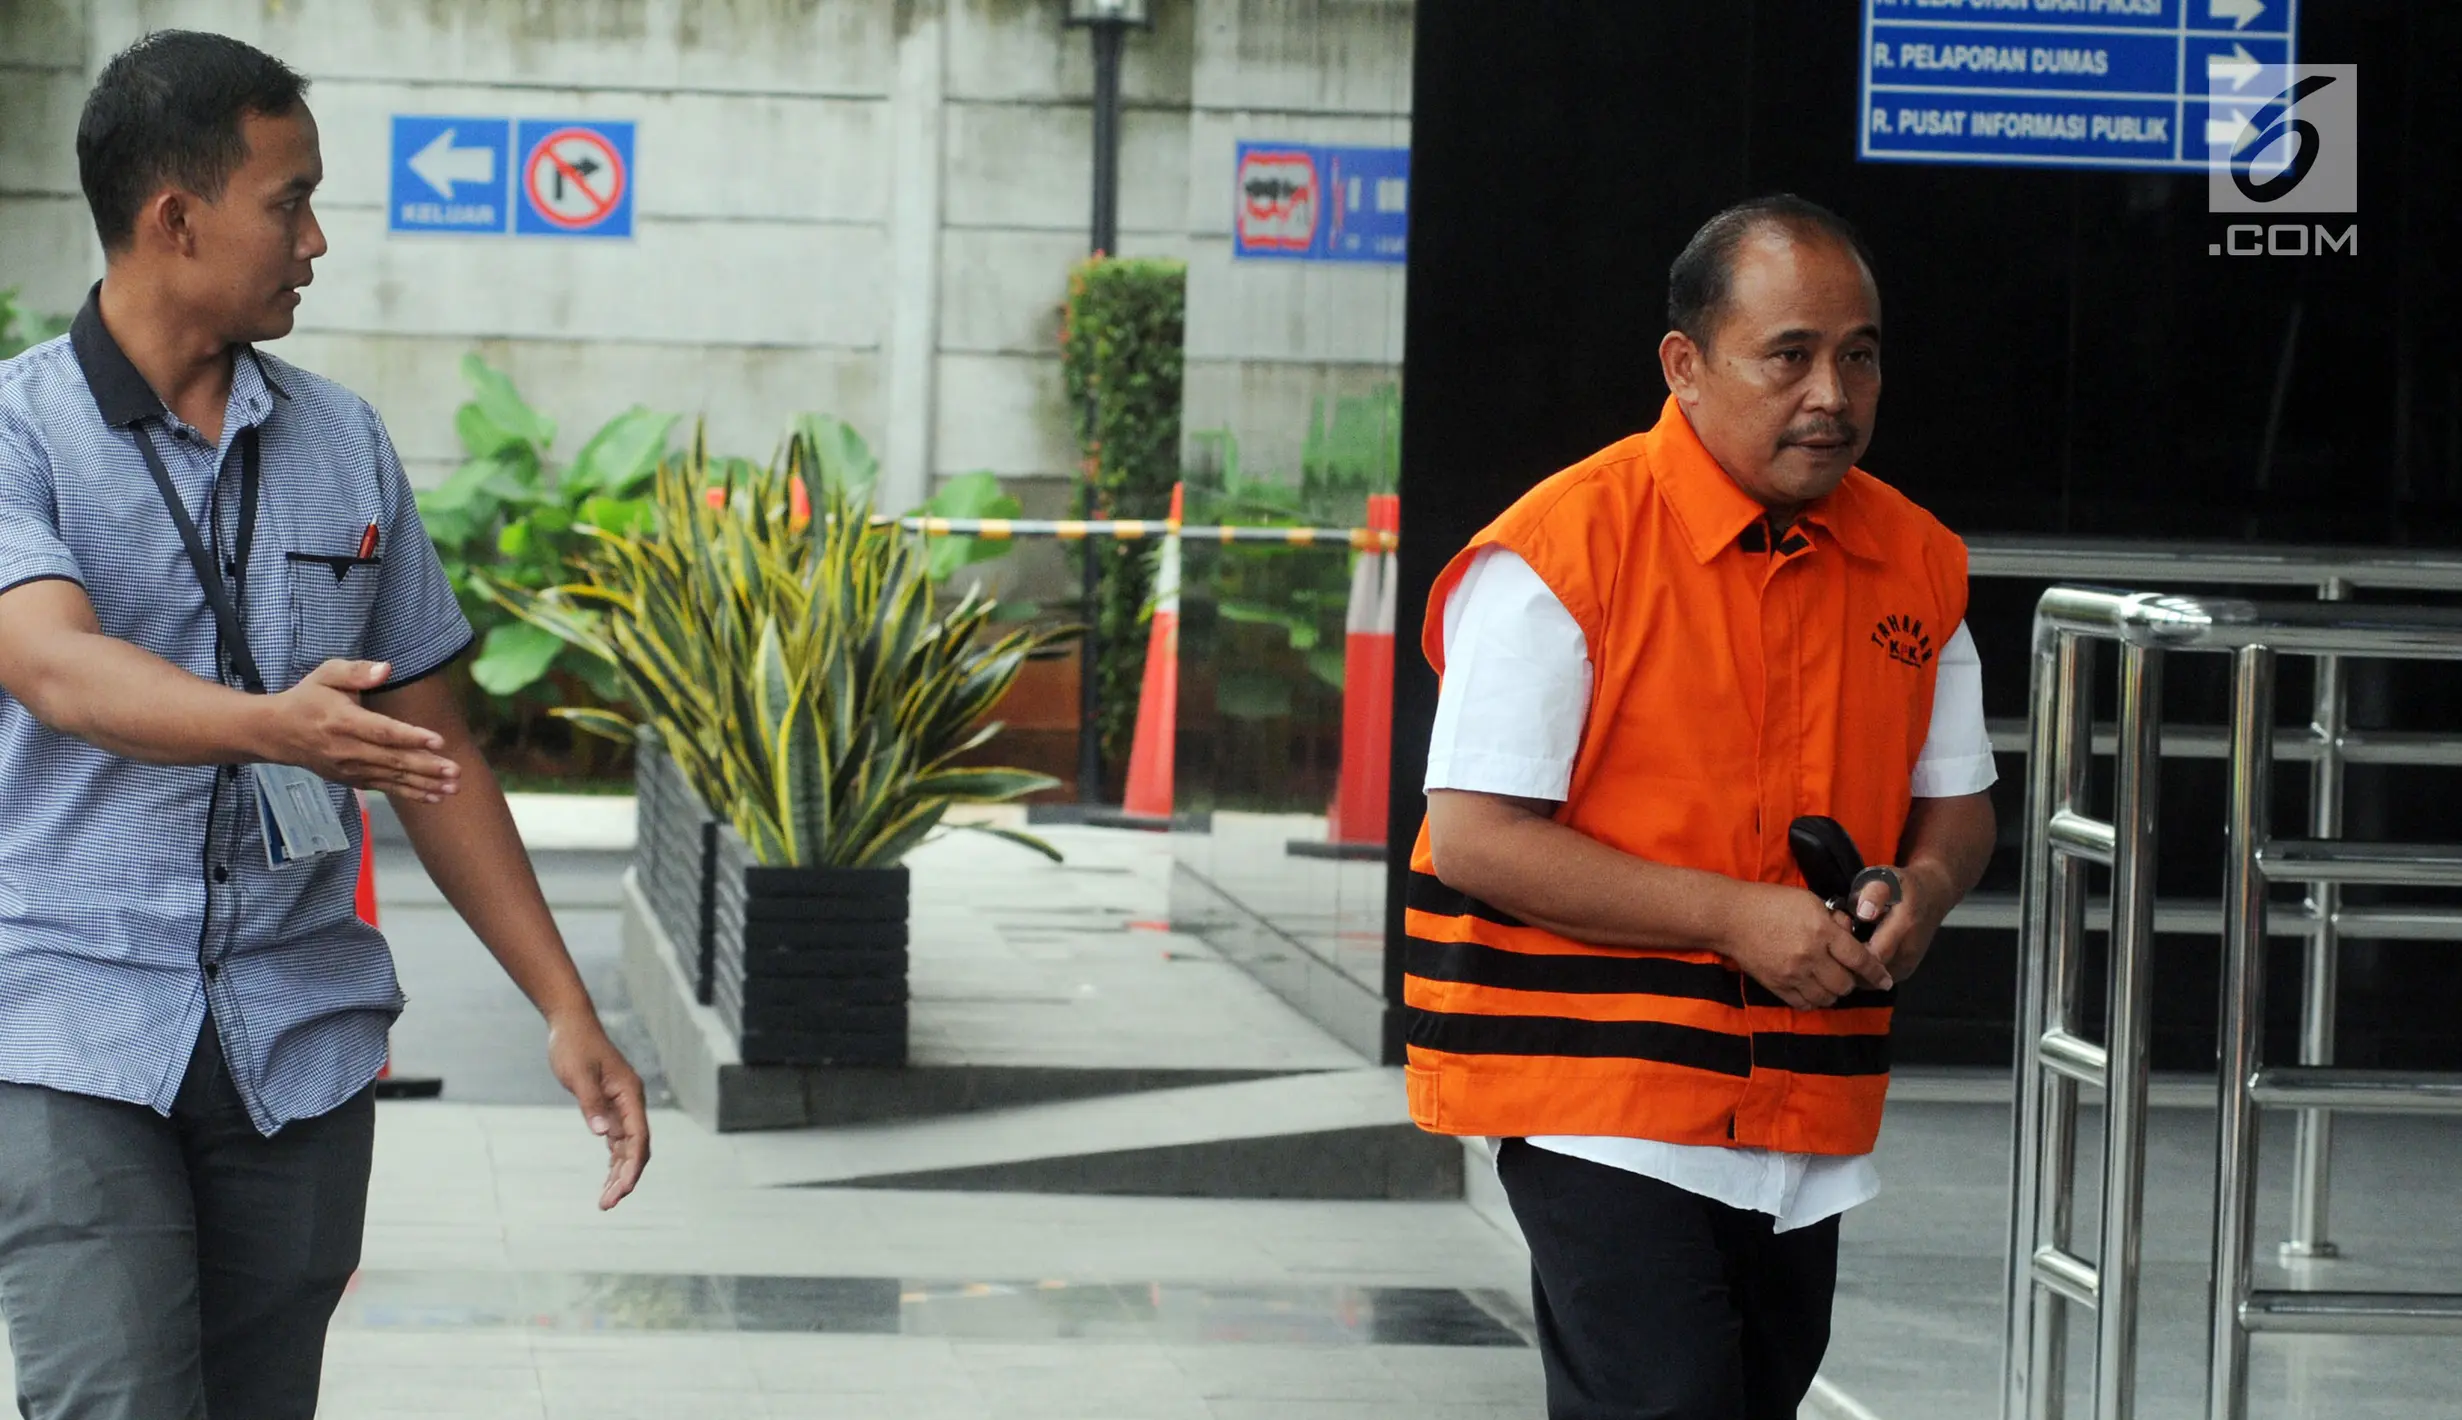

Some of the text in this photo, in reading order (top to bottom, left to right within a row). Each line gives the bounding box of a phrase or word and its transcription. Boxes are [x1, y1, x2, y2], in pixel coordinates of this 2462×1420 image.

[1873, 42, 2109, 75] R. PELAPORAN DUMAS
[1872, 109, 2168, 143] R. PUSAT INFORMASI PUBLIK
[1871, 614, 1933, 663] TAHANAN
